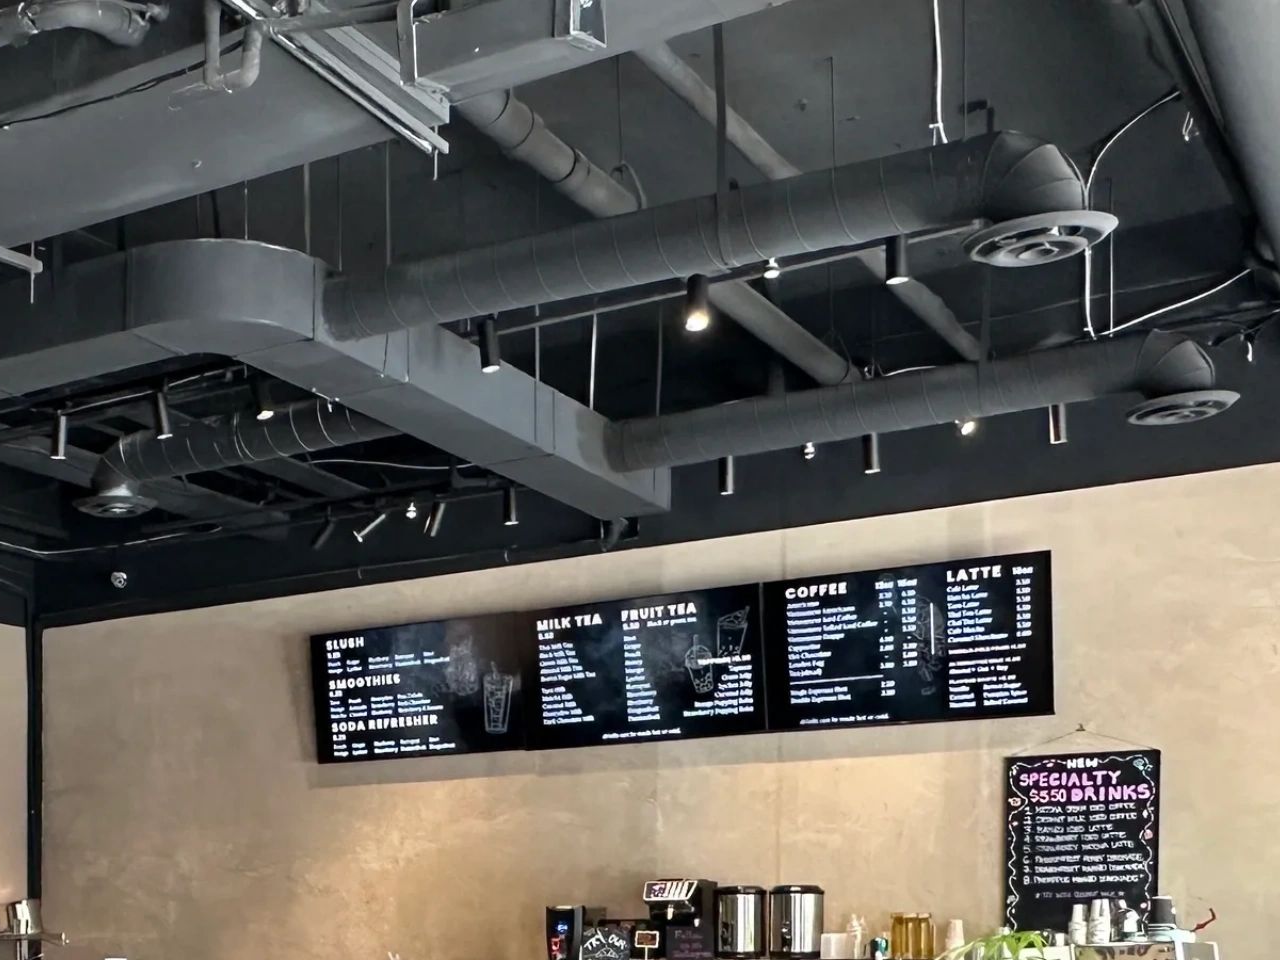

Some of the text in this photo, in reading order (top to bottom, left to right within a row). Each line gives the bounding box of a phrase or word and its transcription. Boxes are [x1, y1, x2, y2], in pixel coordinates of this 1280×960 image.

[946, 565, 1002, 582] LATTE
[785, 582, 847, 599] COFFEE
[621, 602, 696, 621] FRUIT TEA
[536, 613, 602, 631] MILK TEA
[326, 636, 364, 651] SLUSH
[329, 674, 400, 690] SMOOTHIES
[331, 714, 438, 733] SODA REFRESHER
[1067, 758, 1098, 769] NEW
[1019, 771, 1121, 787] SPECIALTY
[1071, 783, 1151, 801] DRINKS
[584, 930, 626, 950] TRY OUR
